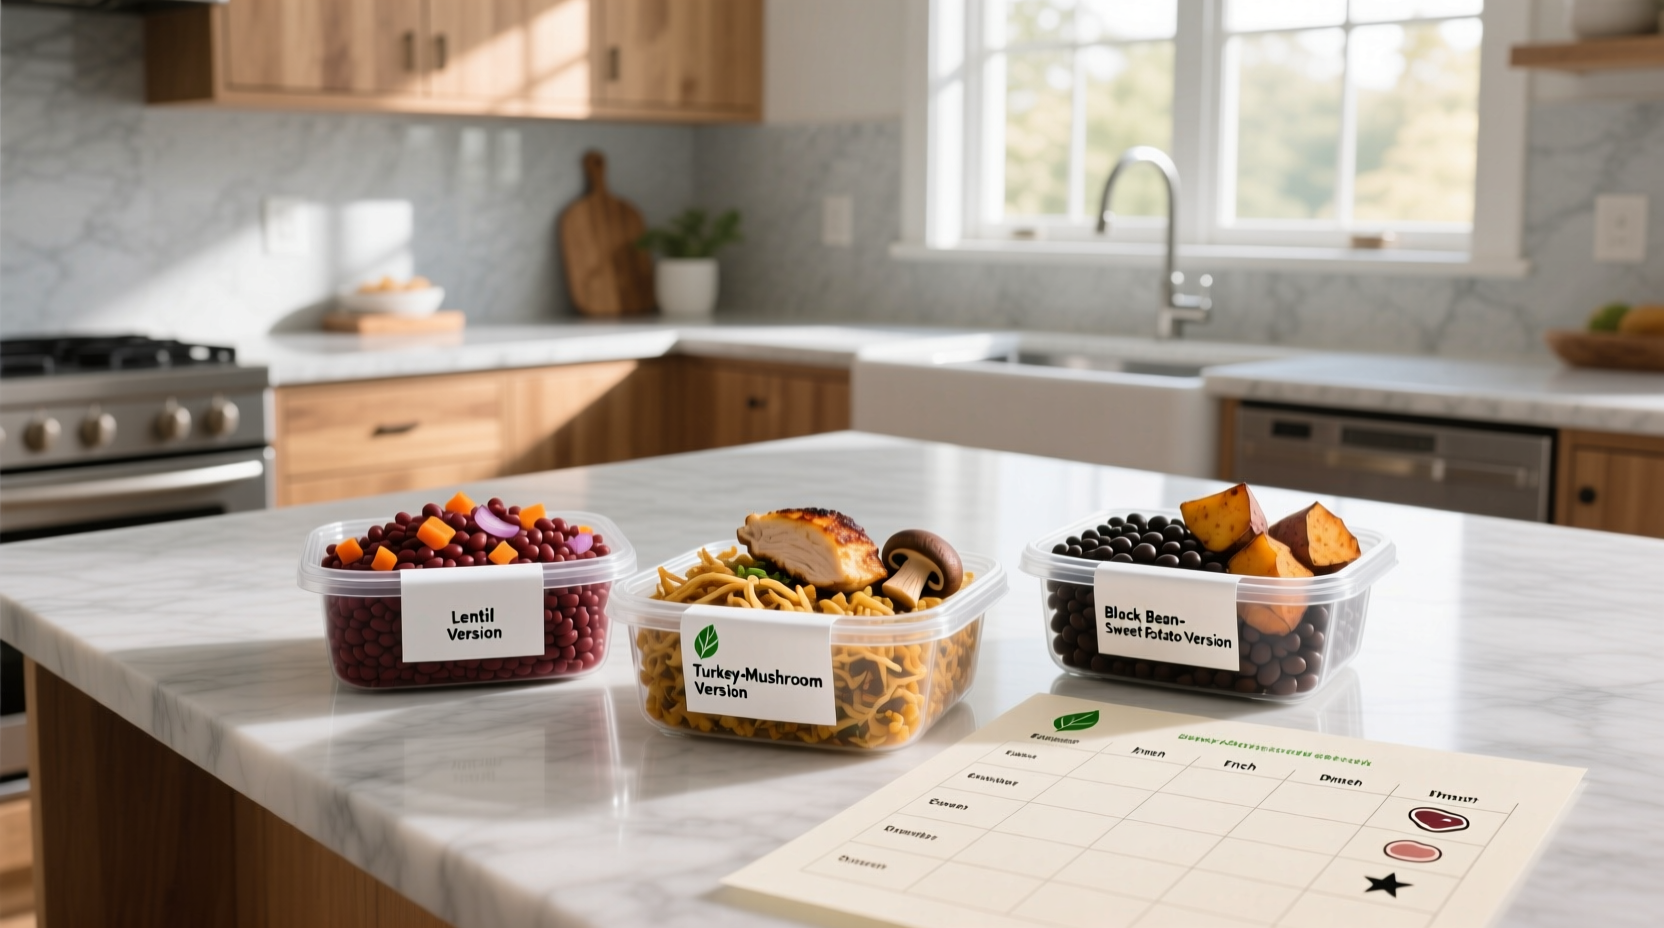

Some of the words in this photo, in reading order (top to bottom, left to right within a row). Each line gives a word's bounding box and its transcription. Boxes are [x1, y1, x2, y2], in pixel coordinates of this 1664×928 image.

[451, 607, 495, 625] Lentil
[446, 626, 503, 641] Version
[1105, 622, 1143, 638] Sweet
[1145, 626, 1183, 643] Potato
[1184, 630, 1232, 649] Version
[692, 663, 823, 688] Turkey-Mushroom
